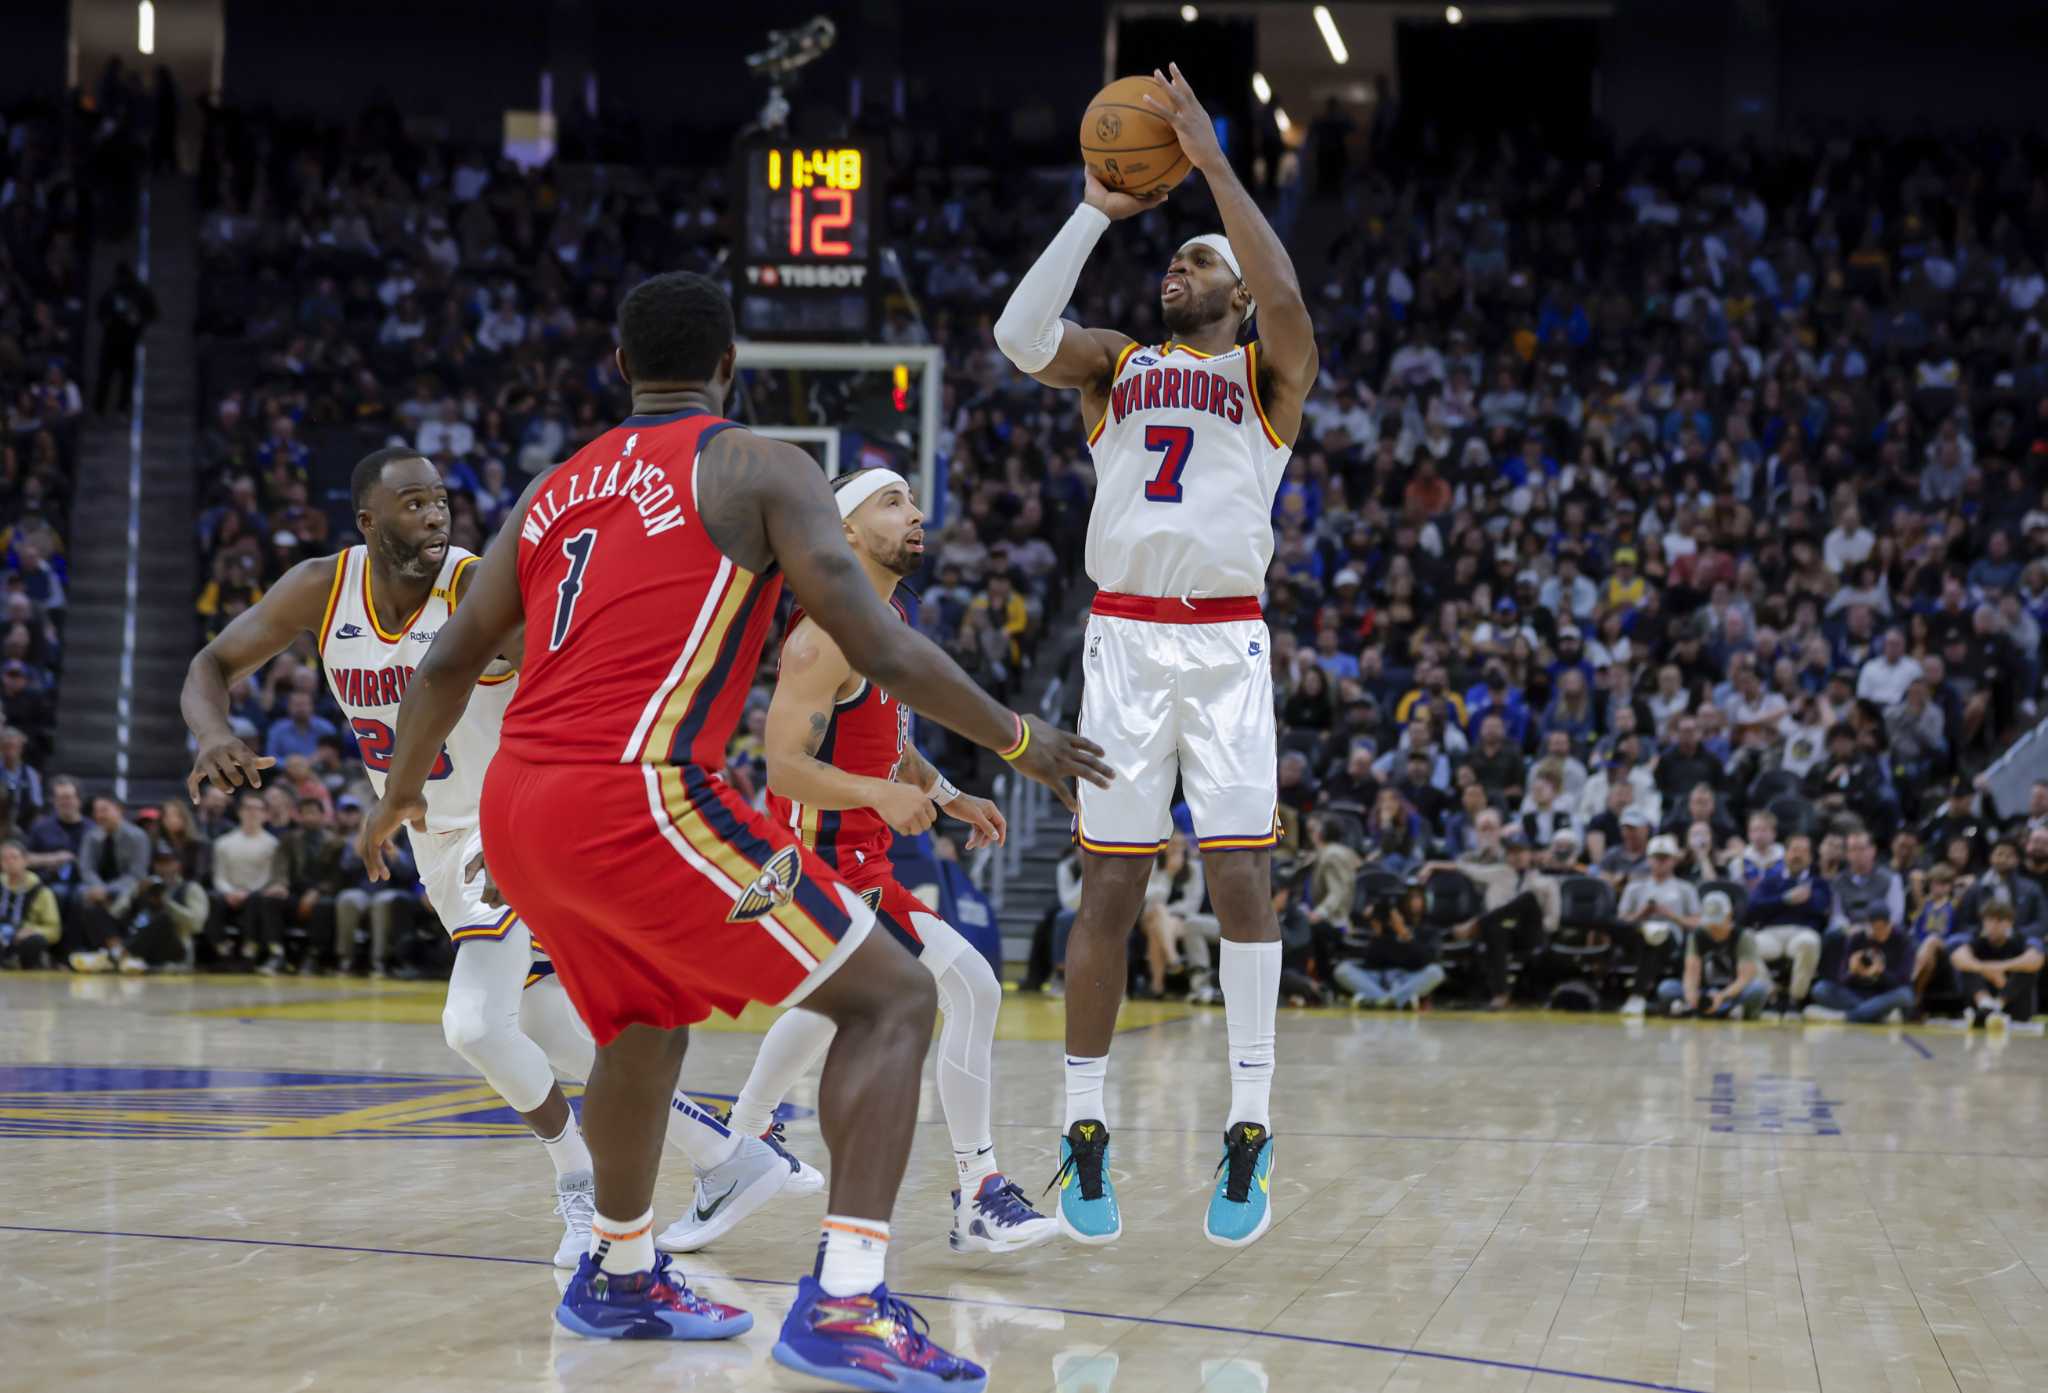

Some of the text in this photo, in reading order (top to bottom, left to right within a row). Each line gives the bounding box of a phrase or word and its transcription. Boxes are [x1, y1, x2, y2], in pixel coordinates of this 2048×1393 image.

[768, 149, 861, 190] 11:48
[790, 187, 852, 256] 12
[780, 265, 866, 286] TISSOT
[1112, 368, 1244, 425] WARRIORS
[1144, 425, 1194, 503] 7
[549, 528, 598, 651] 1
[410, 631, 439, 641] Raku
[331, 665, 417, 707] WARRI
